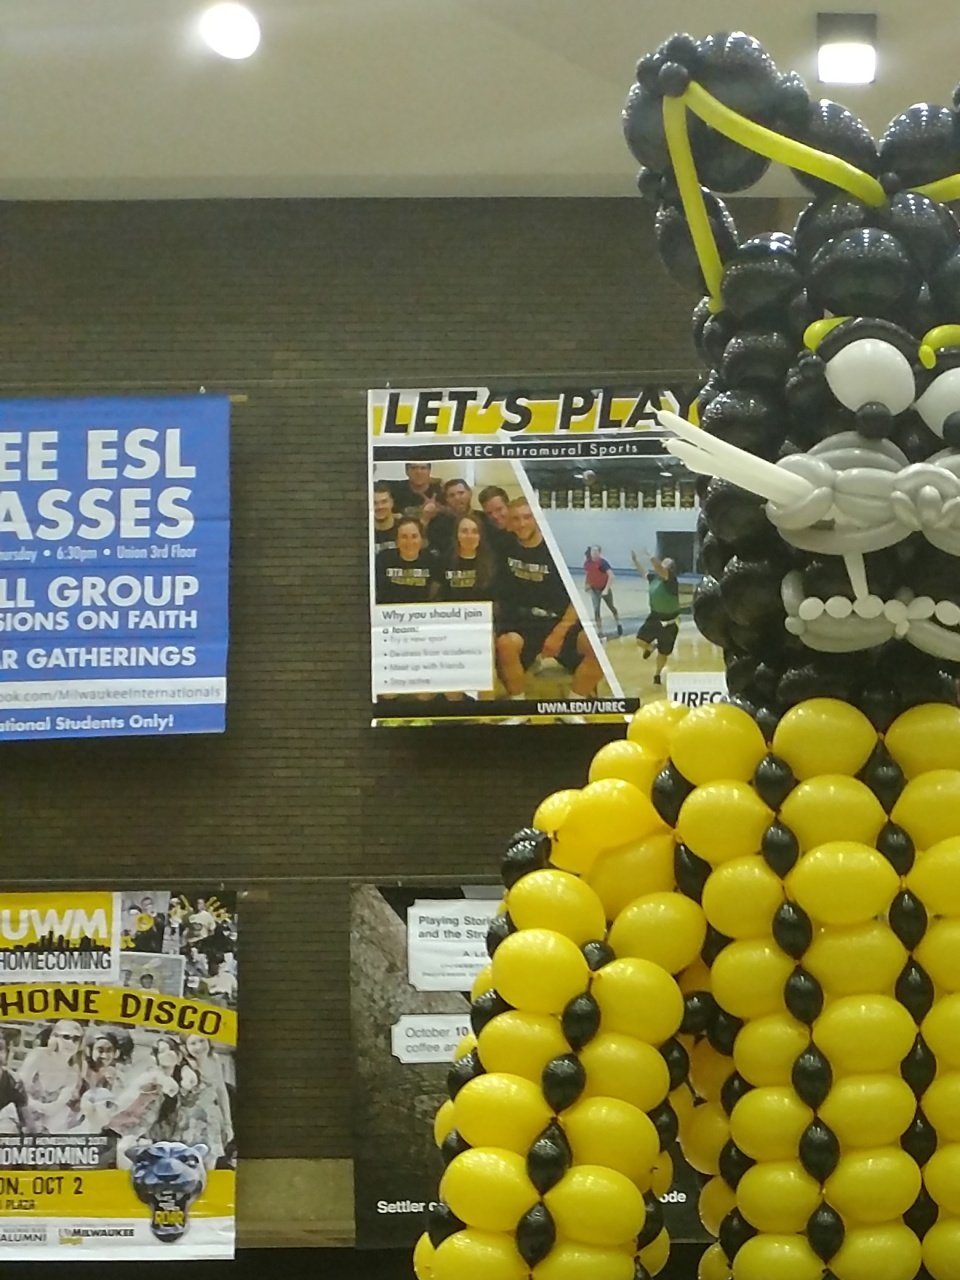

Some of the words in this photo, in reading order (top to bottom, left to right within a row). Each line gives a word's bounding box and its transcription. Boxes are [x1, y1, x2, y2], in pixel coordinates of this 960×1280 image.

[383, 391, 533, 434] LET'S
[0, 431, 58, 482] EE
[87, 428, 197, 480] ESL
[453, 446, 492, 457] UREC
[501, 444, 581, 456] Intramural
[590, 443, 637, 457] Sports
[0, 487, 195, 541] ASSES
[150, 545, 169, 559] 3rd
[171, 544, 197, 558] Floor
[48, 575, 199, 608] GROUP
[77, 610, 119, 631] ON
[128, 610, 198, 630] FAITH
[382, 609, 405, 622] Why
[408, 612, 427, 622] you
[430, 608, 461, 618] should
[464, 608, 482, 620] join
[26, 647, 196, 669] GATHERINGS
[537, 701, 626, 714] UWM.EDU/UREC
[55, 714, 125, 730] Students
[129, 713, 174, 731] Only!
[1, 909, 107, 940] UWM
[418, 915, 459, 926] Playing
[418, 930, 439, 938] and
[444, 930, 461, 938] the
[0, 988, 100, 1016] HONE
[121, 996, 222, 1037] DISCO
[405, 1027, 450, 1038] October
[456, 1026, 468, 1036] 10
[406, 1043, 440, 1053] coffee
[33, 1177, 64, 1195] OCT
[73, 1176, 83, 1194] 2
[377, 1200, 426, 1213] Settler
[155, 1211, 184, 1224] ROAR
[0, 1234, 46, 1242] ALUMNI
